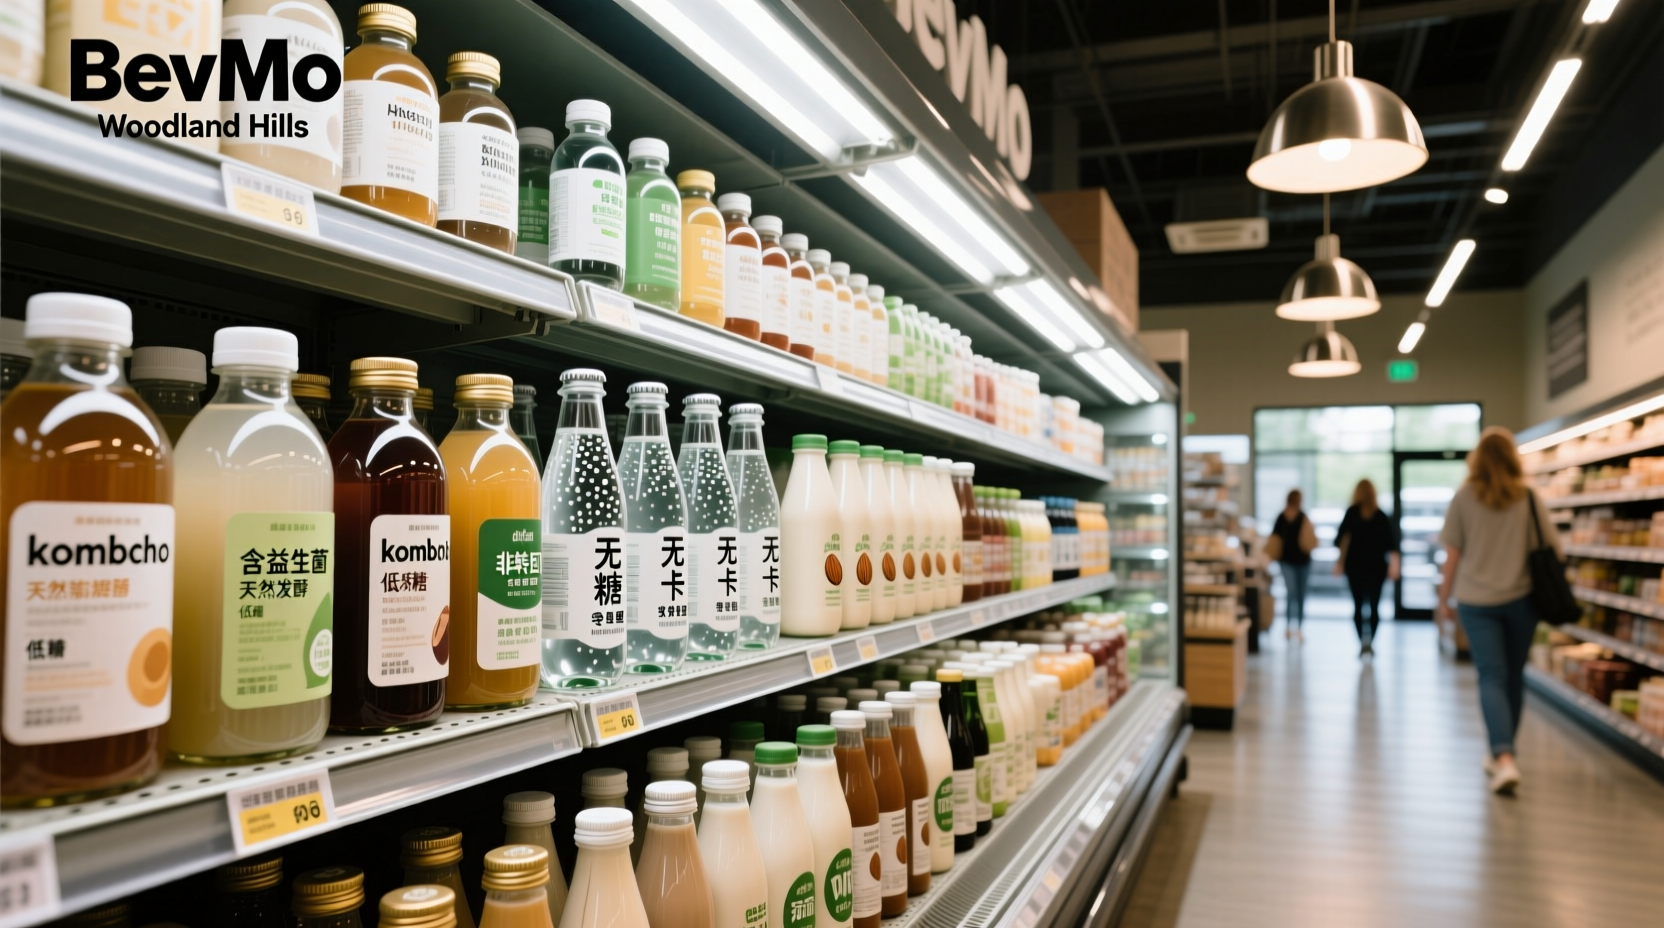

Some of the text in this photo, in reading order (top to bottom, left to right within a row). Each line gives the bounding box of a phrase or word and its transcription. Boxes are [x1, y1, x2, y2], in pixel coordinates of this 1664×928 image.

[894, 0, 1033, 181] evMo
[27, 534, 170, 566] kombcho
[240, 547, 329, 576] 含益生菌
[593, 537, 623, 606] 无糖
[661, 536, 685, 602] 无卡
[717, 536, 738, 597] 无卡
[762, 536, 780, 593] 无卡
